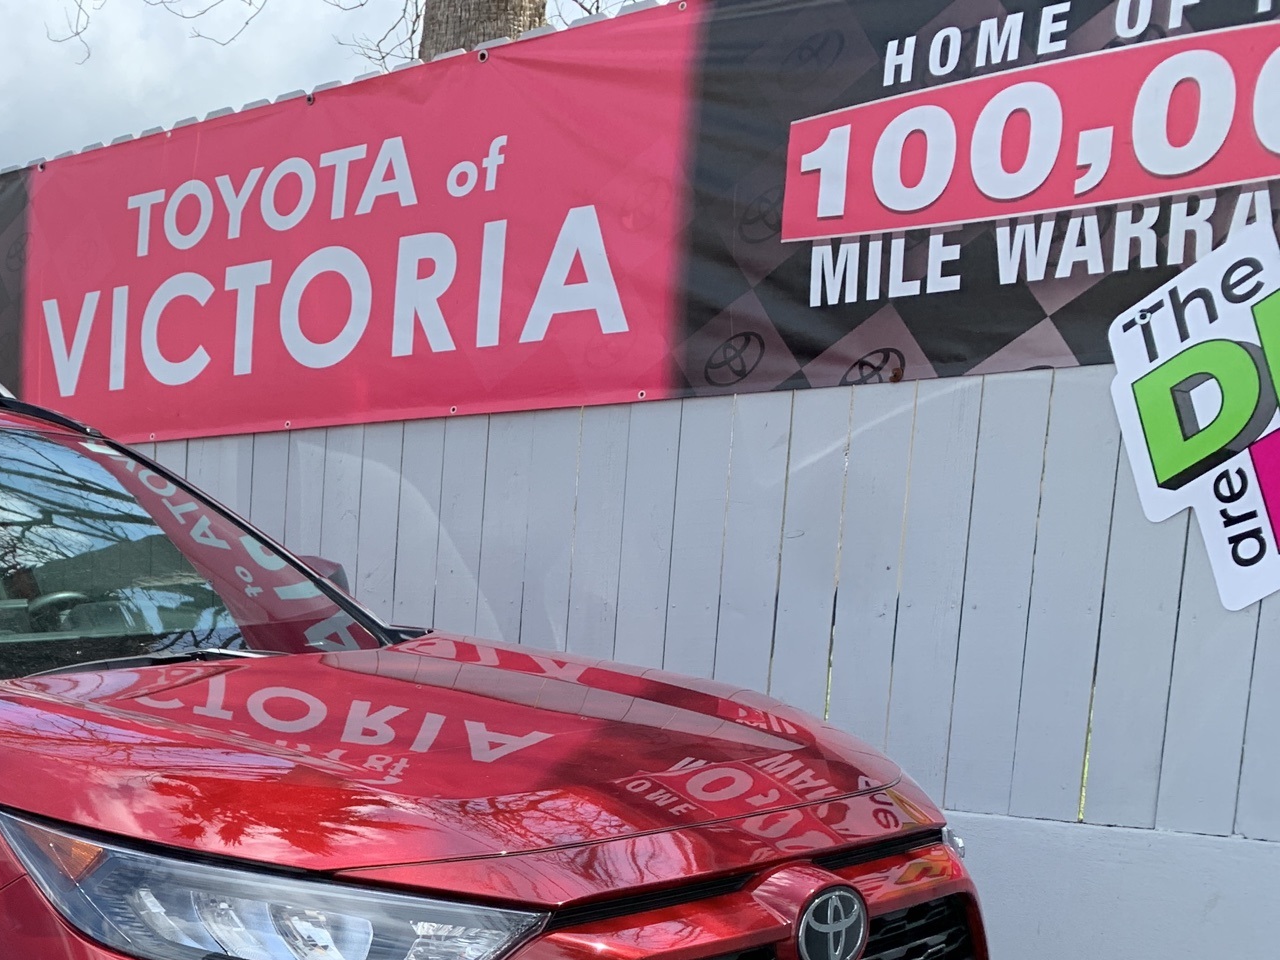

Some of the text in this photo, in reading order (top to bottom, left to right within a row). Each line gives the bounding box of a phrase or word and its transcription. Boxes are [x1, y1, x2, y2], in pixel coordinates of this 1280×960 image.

[883, 2, 1070, 86] HOME
[800, 47, 1280, 218] 100,0
[127, 135, 508, 257] TOYOTA of
[42, 204, 630, 398] VICTORIA
[810, 233, 961, 307] MILE
[1122, 257, 1265, 363] The
[1131, 290, 1280, 490] D
[1213, 467, 1267, 567] are
